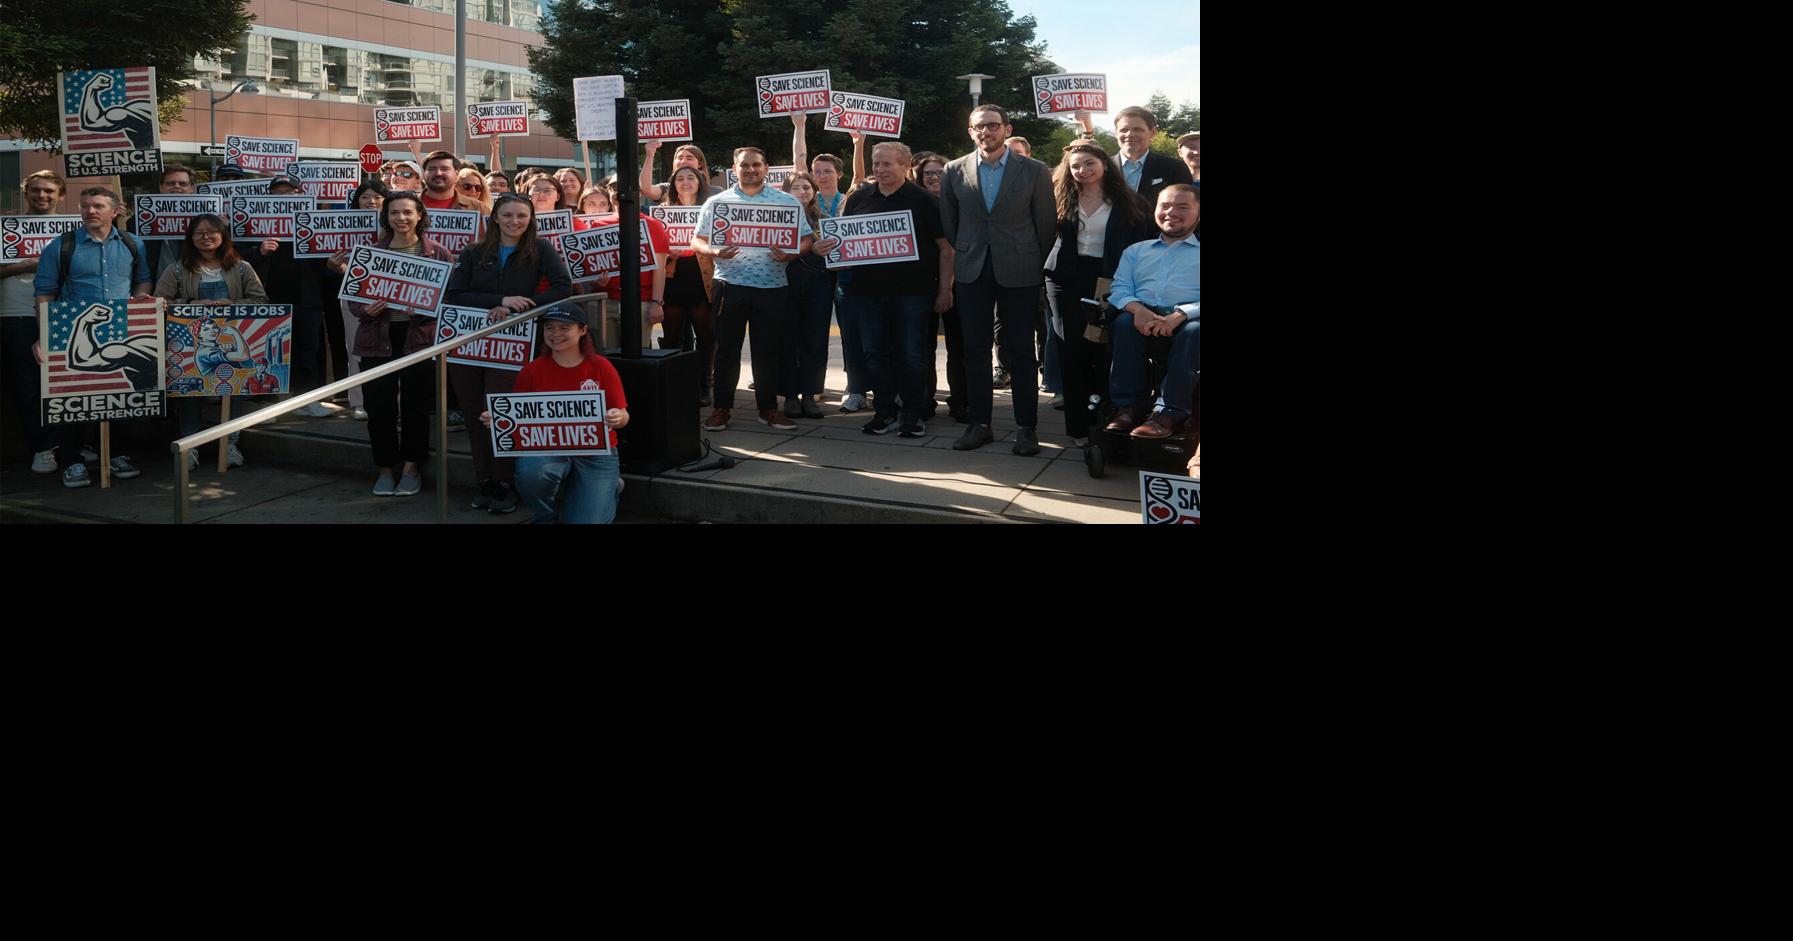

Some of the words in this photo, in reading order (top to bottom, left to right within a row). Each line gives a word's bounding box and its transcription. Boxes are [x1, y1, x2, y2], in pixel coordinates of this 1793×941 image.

[773, 80, 791, 92] SAVE
[792, 76, 824, 89] SCIENCE
[1052, 79, 1072, 91] SAVE
[1074, 78, 1103, 90] SCIENCE
[775, 94, 798, 110] SAVE
[799, 92, 825, 108] LIVES
[846, 98, 865, 110] SAVE
[867, 101, 898, 115] SCIENCE
[1056, 95, 1080, 109] SAVE
[1082, 94, 1103, 108] LIVES
[389, 112, 406, 122] SAVE
[408, 111, 435, 121] SCIENCE
[478, 106, 494, 116] SAVE
[495, 104, 523, 115] SCIENCE
[654, 105, 684, 117] SCIENCE
[480, 120, 501, 133] SAVE
[502, 118, 523, 131] LIVES
[638, 123, 659, 137] SAVE
[660, 121, 685, 135] LIVES
[844, 113, 868, 128] SAVE
[869, 116, 895, 131] LIVES
[391, 126, 413, 139] SAVE
[414, 125, 435, 137] LIVES
[242, 141, 260, 152] SAVE
[262, 143, 293, 153] SCIENCE
[68, 149, 158, 168] SCIENCE
[242, 155, 266, 169] SAVE
[360, 153, 382, 164] STOP
[69, 168, 80, 176] IS
[82, 166, 102, 176] U.S.
[102, 164, 159, 175] STRENGTH
[301, 167, 320, 179] SAVE
[322, 167, 355, 179] SCIENCE
[302, 183, 326, 196] SAVE
[156, 201, 177, 213] SAVE
[180, 200, 216, 212] SCIENCE
[249, 202, 271, 213] SAVE
[313, 216, 336, 229] SAVE
[338, 216, 373, 228] SCIENCE
[435, 215, 472, 230] SCIENCE
[668, 212, 688, 223] SAVE
[731, 208, 754, 222] SAVE
[756, 209, 795, 224] SCIENCE
[22, 222, 46, 234] SAVE
[49, 221, 83, 234] SCIEN
[158, 218, 184, 232] SAVE
[251, 219, 278, 234] SAVE
[536, 216, 567, 232] CIENCE
[841, 222, 865, 236] SAVE
[867, 218, 907, 233] SCIENCE
[316, 235, 343, 250] SAVE
[345, 234, 372, 250] LIVES
[440, 234, 469, 251] LIVES
[581, 234, 604, 250] SAVE
[669, 229, 694, 242] SAVE
[731, 227, 760, 244] SAVE
[762, 228, 792, 246] LIVES
[24, 239, 48, 254] SAV
[845, 241, 875, 258] SAVE
[876, 237, 909, 255] LIVES
[372, 256, 398, 274] SAVE
[399, 262, 443, 283] SCIENCE
[588, 252, 617, 272] SAVE
[366, 278, 400, 300] SAVE
[401, 284, 436, 308] LIVES
[173, 305, 231, 316] SCIENCE
[235, 306, 247, 316] IS
[250, 306, 285, 316] JOBS
[459, 314, 484, 330] SAVE
[457, 338, 488, 358] SAVE
[490, 340, 524, 362] LIVES
[48, 392, 160, 413] SCIENCE
[515, 401, 544, 419] SAVE
[547, 400, 597, 418] SCIENCE
[48, 414, 61, 424] IS
[64, 412, 89, 422] U.S.
[90, 406, 160, 421] STRENGTH
[520, 426, 557, 447] SAVE
[559, 425, 598, 446] LIVES
